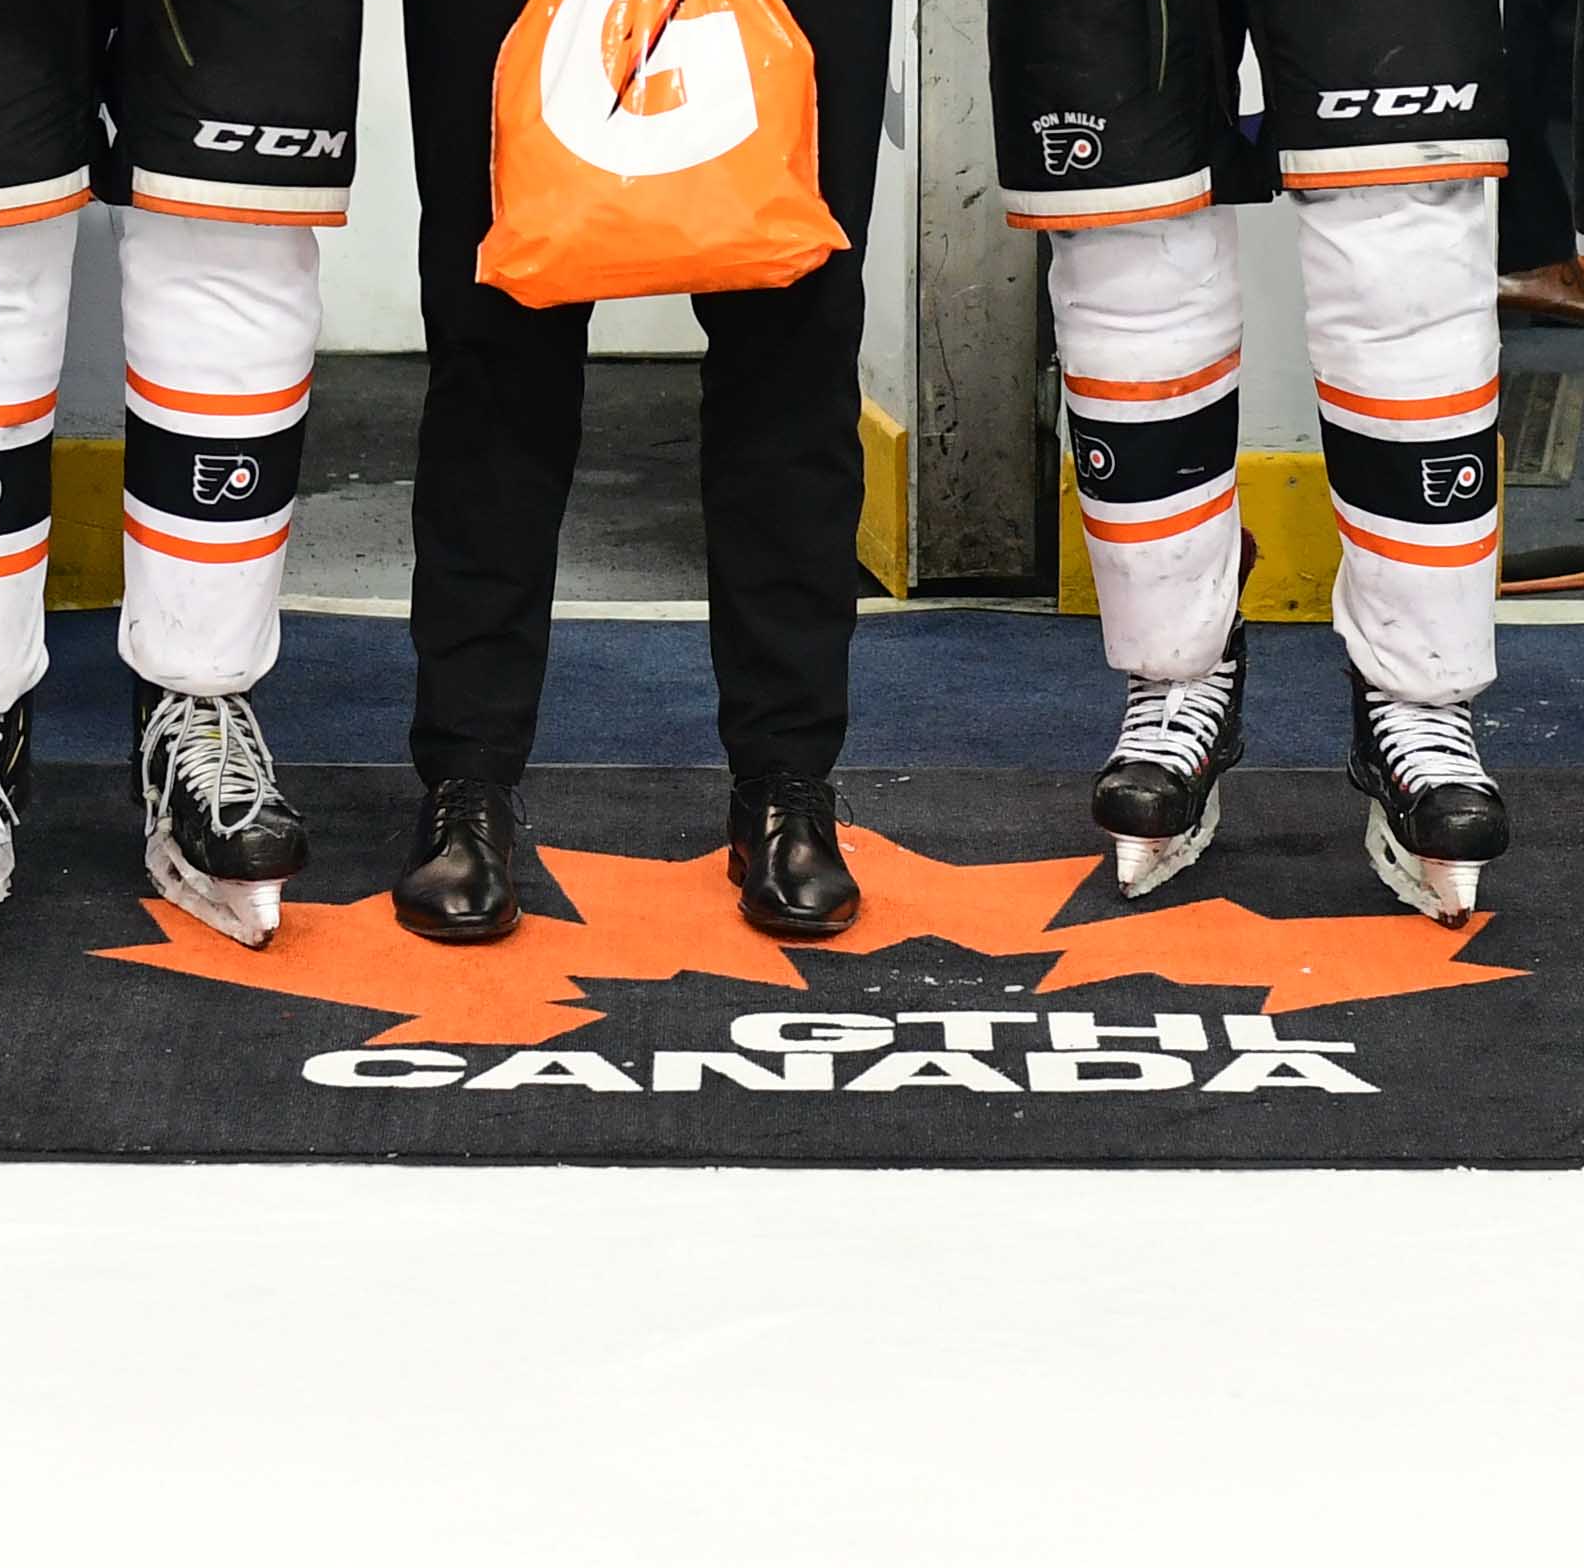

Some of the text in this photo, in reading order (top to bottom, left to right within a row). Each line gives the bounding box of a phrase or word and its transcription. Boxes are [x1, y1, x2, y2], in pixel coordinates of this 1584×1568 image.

[1316, 83, 1480, 120] CCM
[192, 119, 349, 160] CCM
[1032, 111, 1107, 134] DON MILLS
[729, 1011, 1358, 1055] GTHL
[301, 1050, 1383, 1095] CANADA
